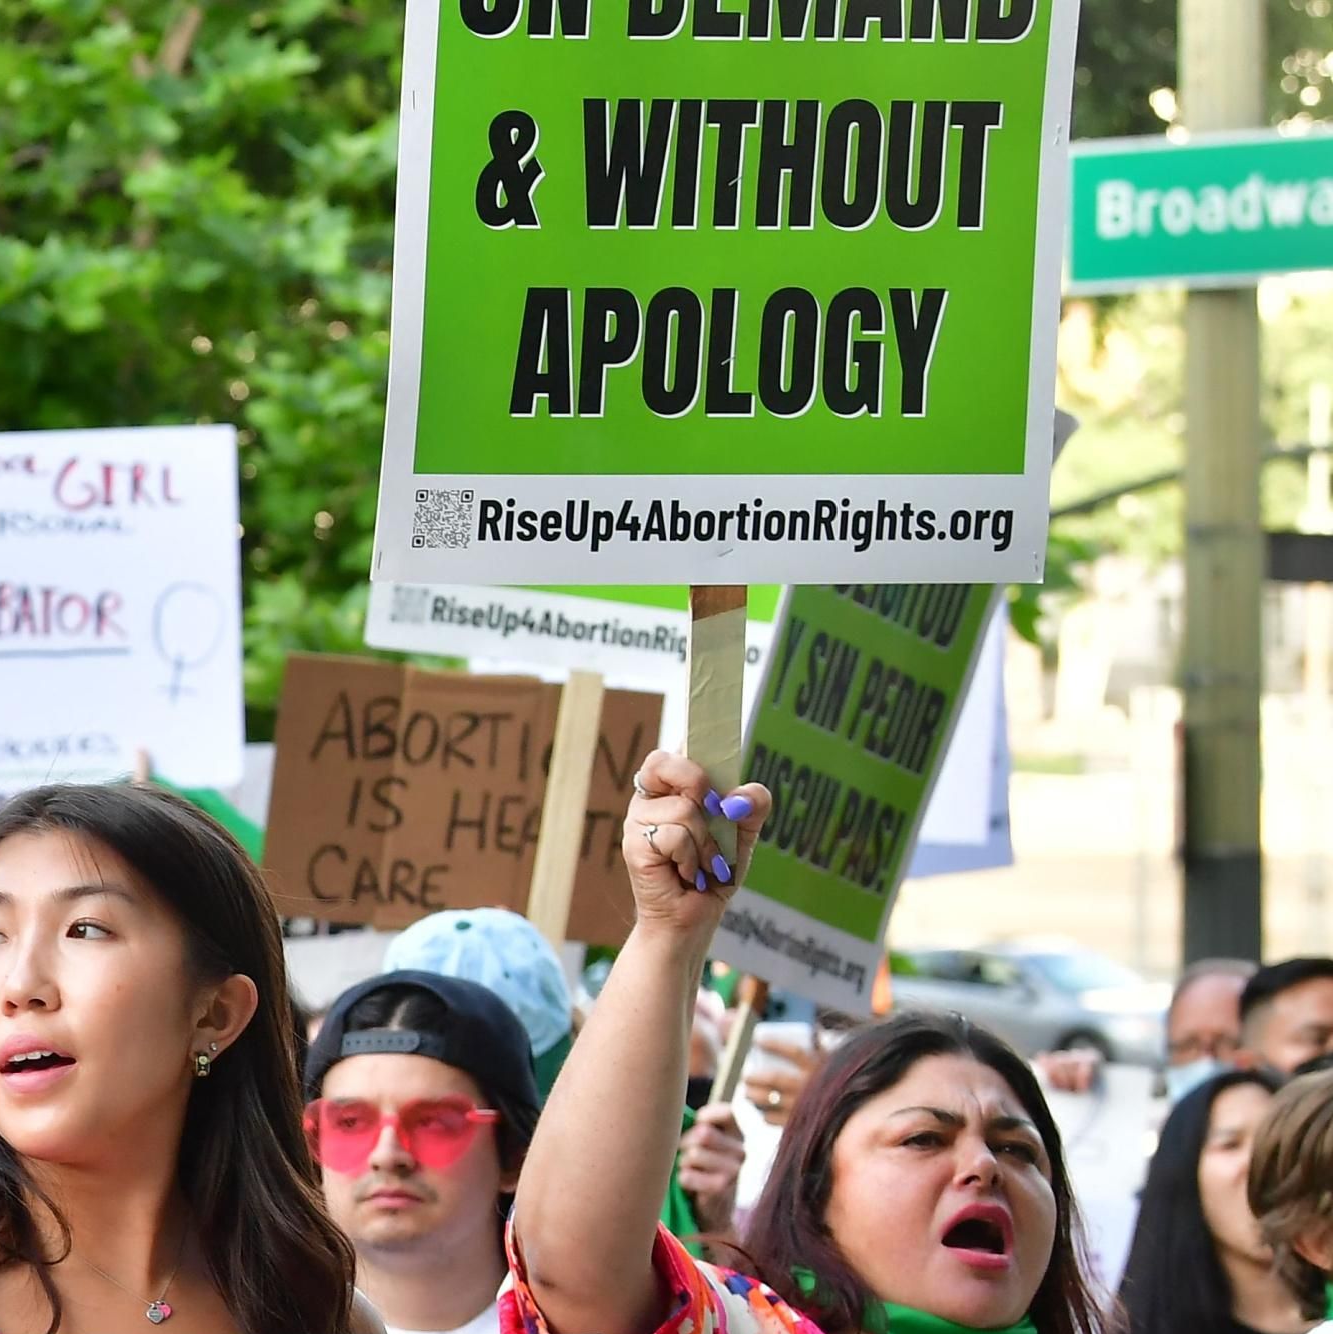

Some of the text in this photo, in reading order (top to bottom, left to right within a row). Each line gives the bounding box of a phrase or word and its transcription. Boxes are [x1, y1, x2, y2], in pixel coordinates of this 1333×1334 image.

[475, 97, 1004, 231] & WITHOUT
[509, 285, 949, 419] APOLOGY
[52, 456, 182, 512] GIRL
[478, 498, 1014, 552] RiseUp4AbortionRights.org
[773, 615, 807, 707] Y
[795, 631, 861, 734] SIN
[310, 690, 645, 793] ABORTIN
[346, 776, 408, 834] IS
[306, 844, 452, 910] CARE
